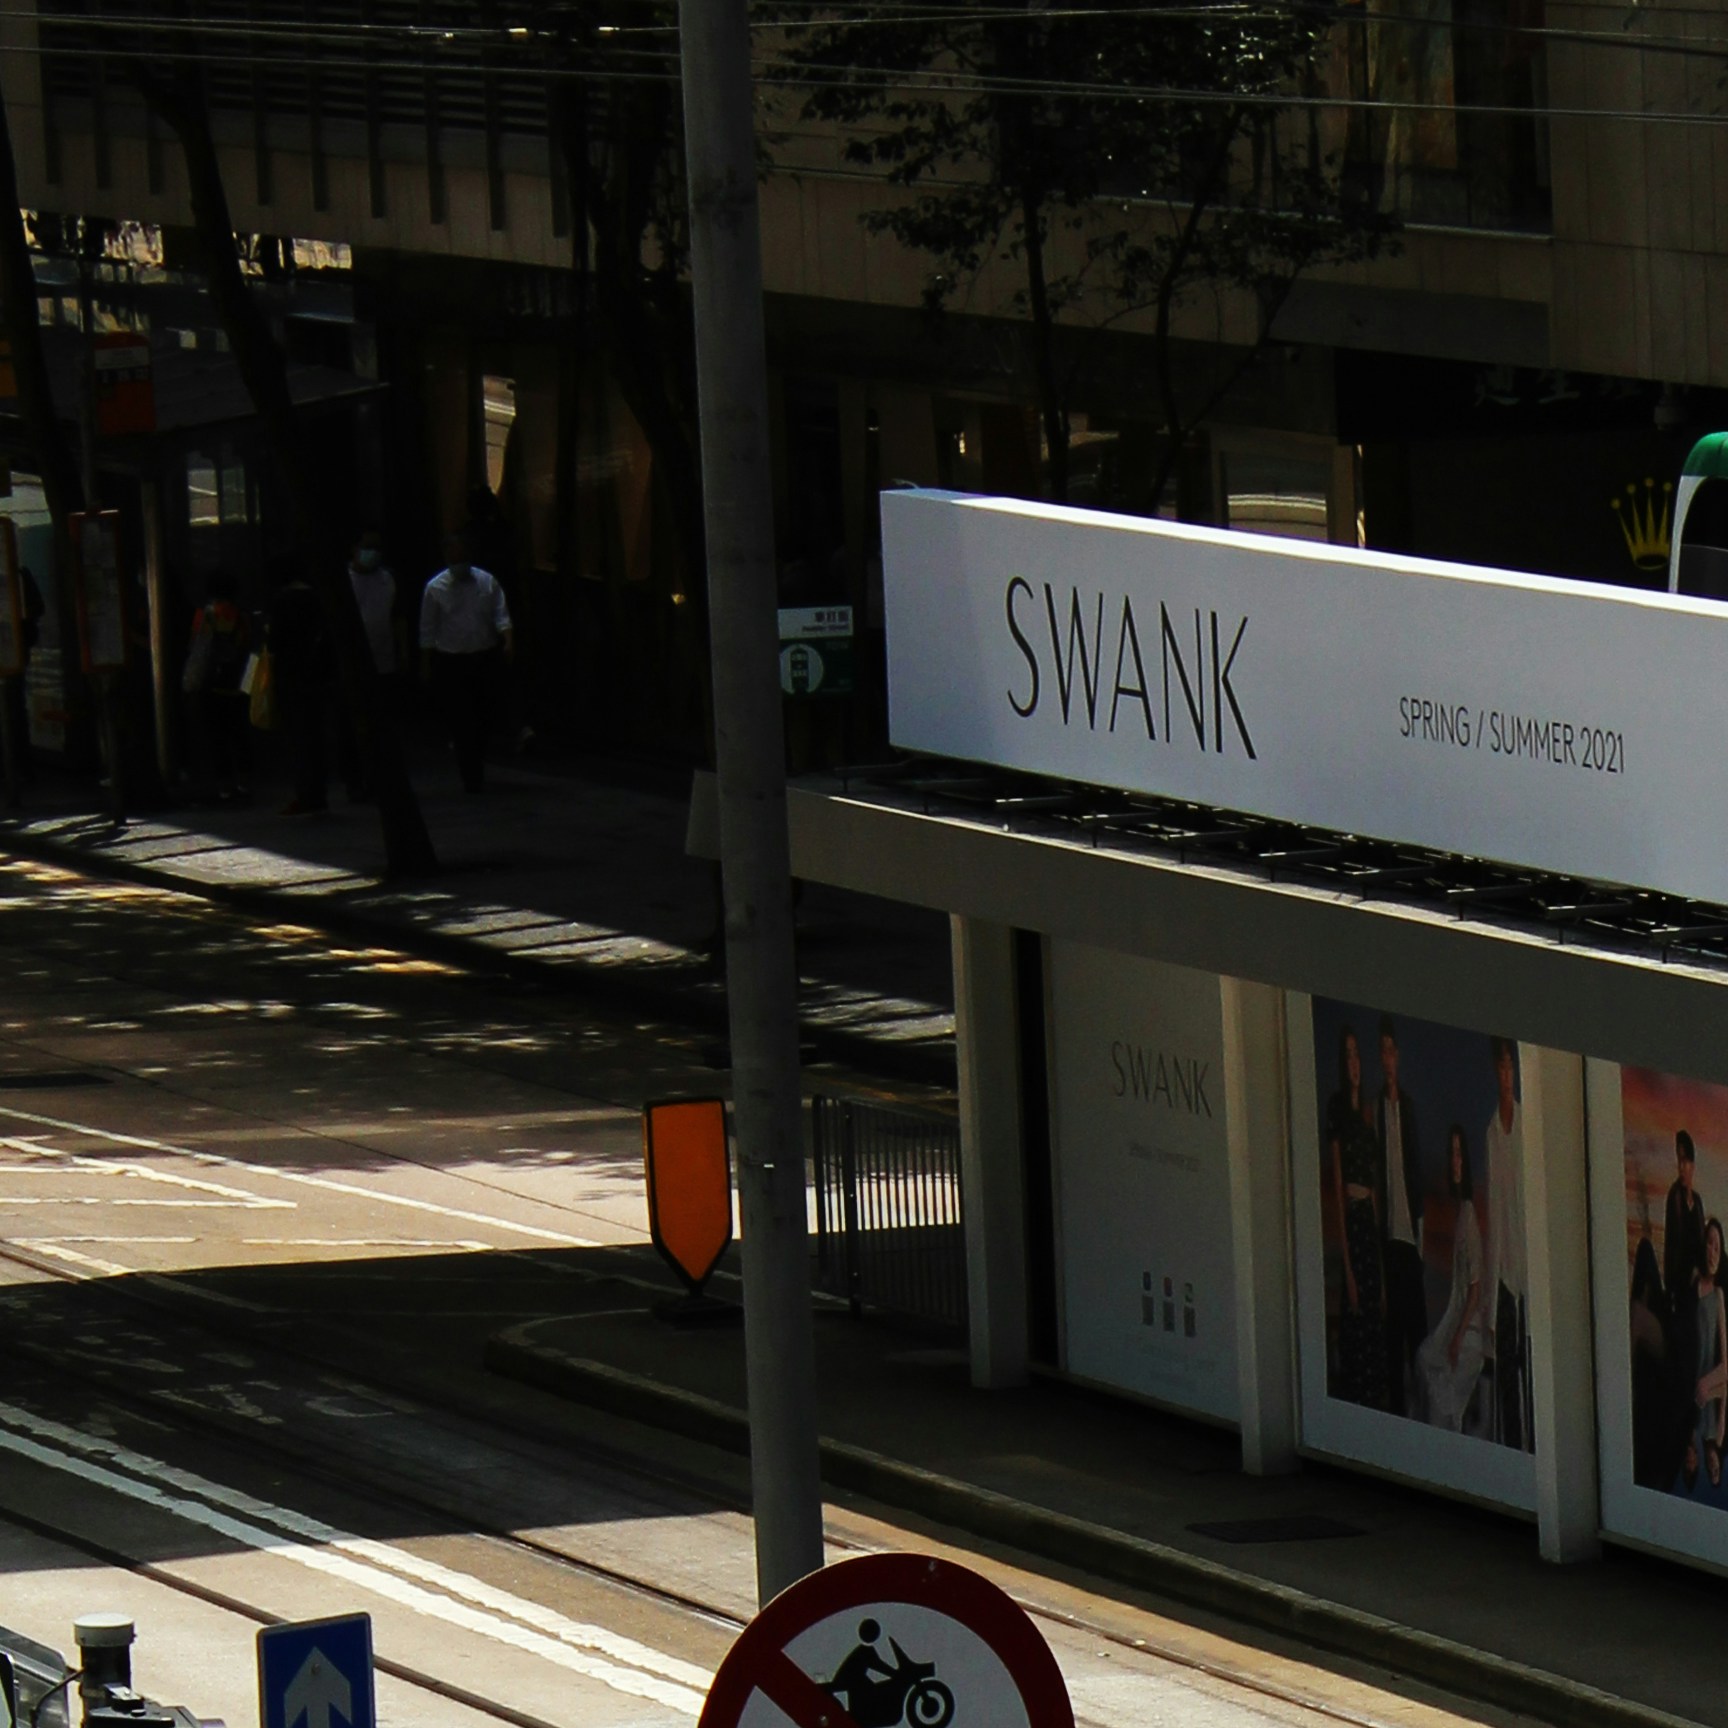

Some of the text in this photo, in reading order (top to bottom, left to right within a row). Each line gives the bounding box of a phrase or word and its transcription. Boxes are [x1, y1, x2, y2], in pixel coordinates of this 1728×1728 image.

[1006, 576, 1257, 760] SWANK
[1399, 696, 1624, 774] SPRING / SUMMER 2021
[1111, 1041, 1212, 1118] SWANK
